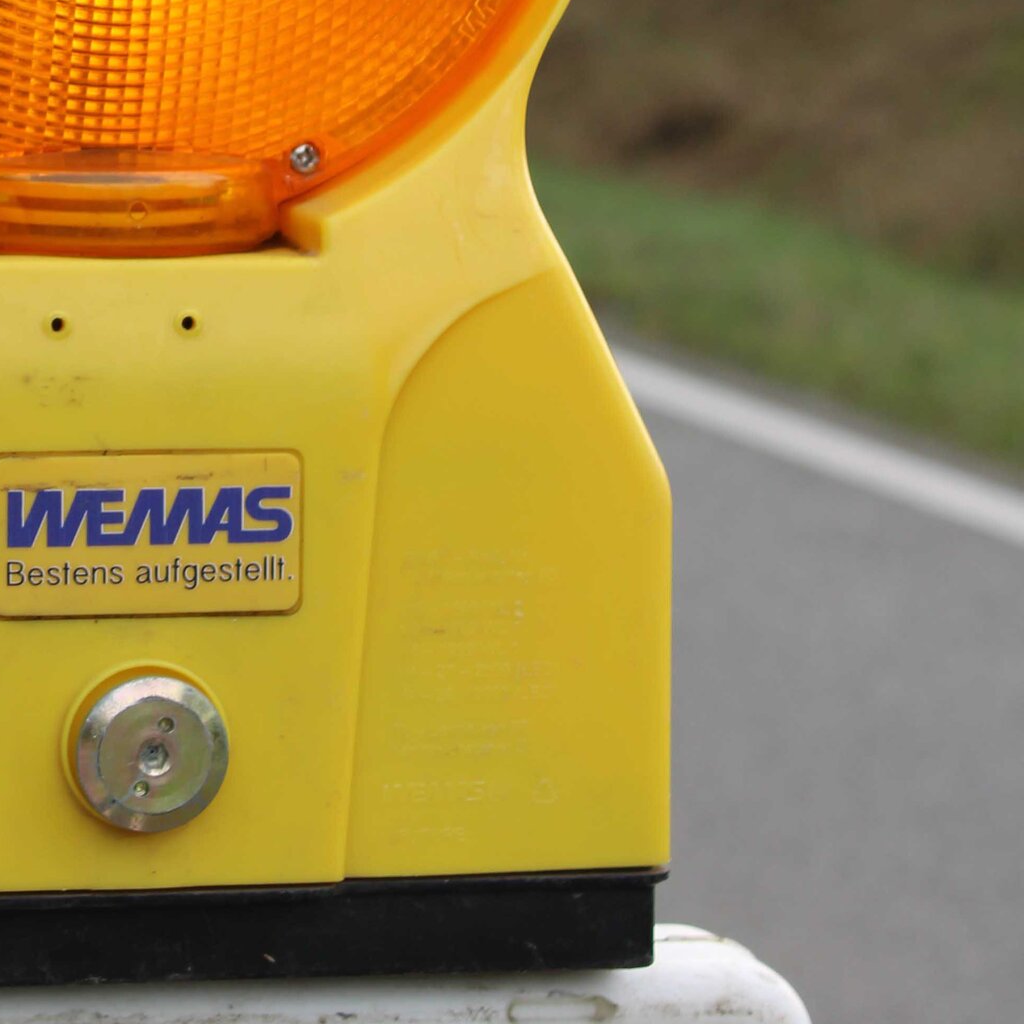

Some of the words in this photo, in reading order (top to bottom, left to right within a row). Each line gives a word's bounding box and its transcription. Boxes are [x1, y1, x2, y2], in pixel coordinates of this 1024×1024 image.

[7, 485, 293, 547] WEMAS
[6, 560, 124, 587] Bestens
[136, 556, 293, 590] aufgestellt.
